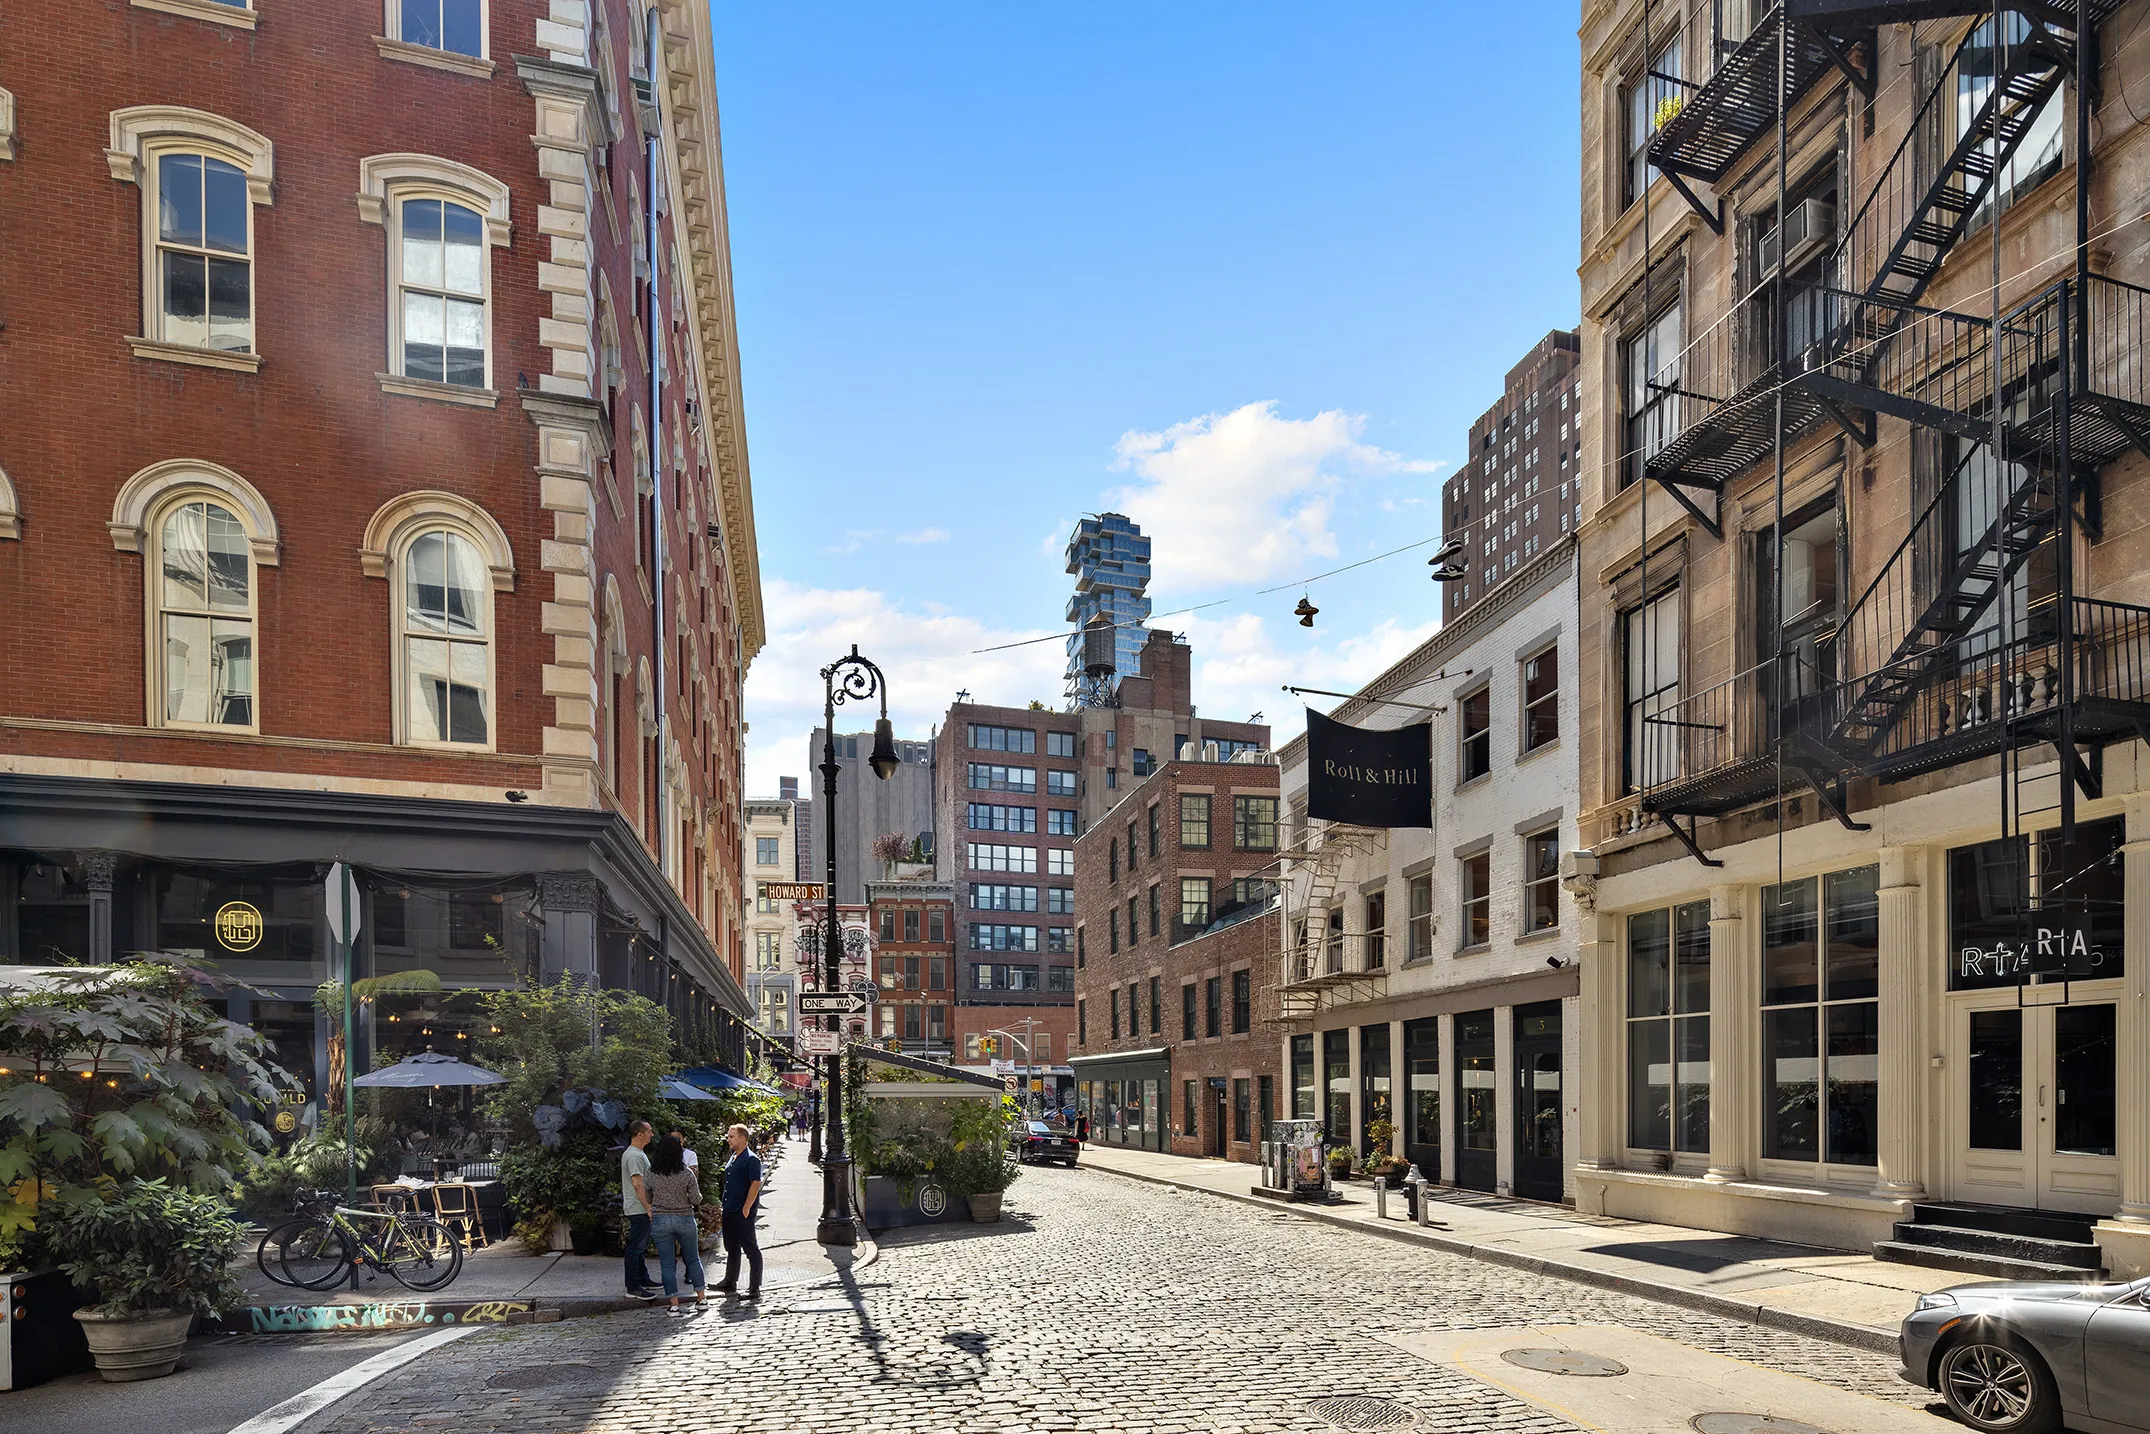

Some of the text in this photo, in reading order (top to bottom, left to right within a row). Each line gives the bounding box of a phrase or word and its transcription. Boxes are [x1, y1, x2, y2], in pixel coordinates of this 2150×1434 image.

[1325, 759, 1417, 784] Roll & Hill
[769, 885, 823, 899] HOWARD ST
[804, 999, 858, 1008] ONE WAY
